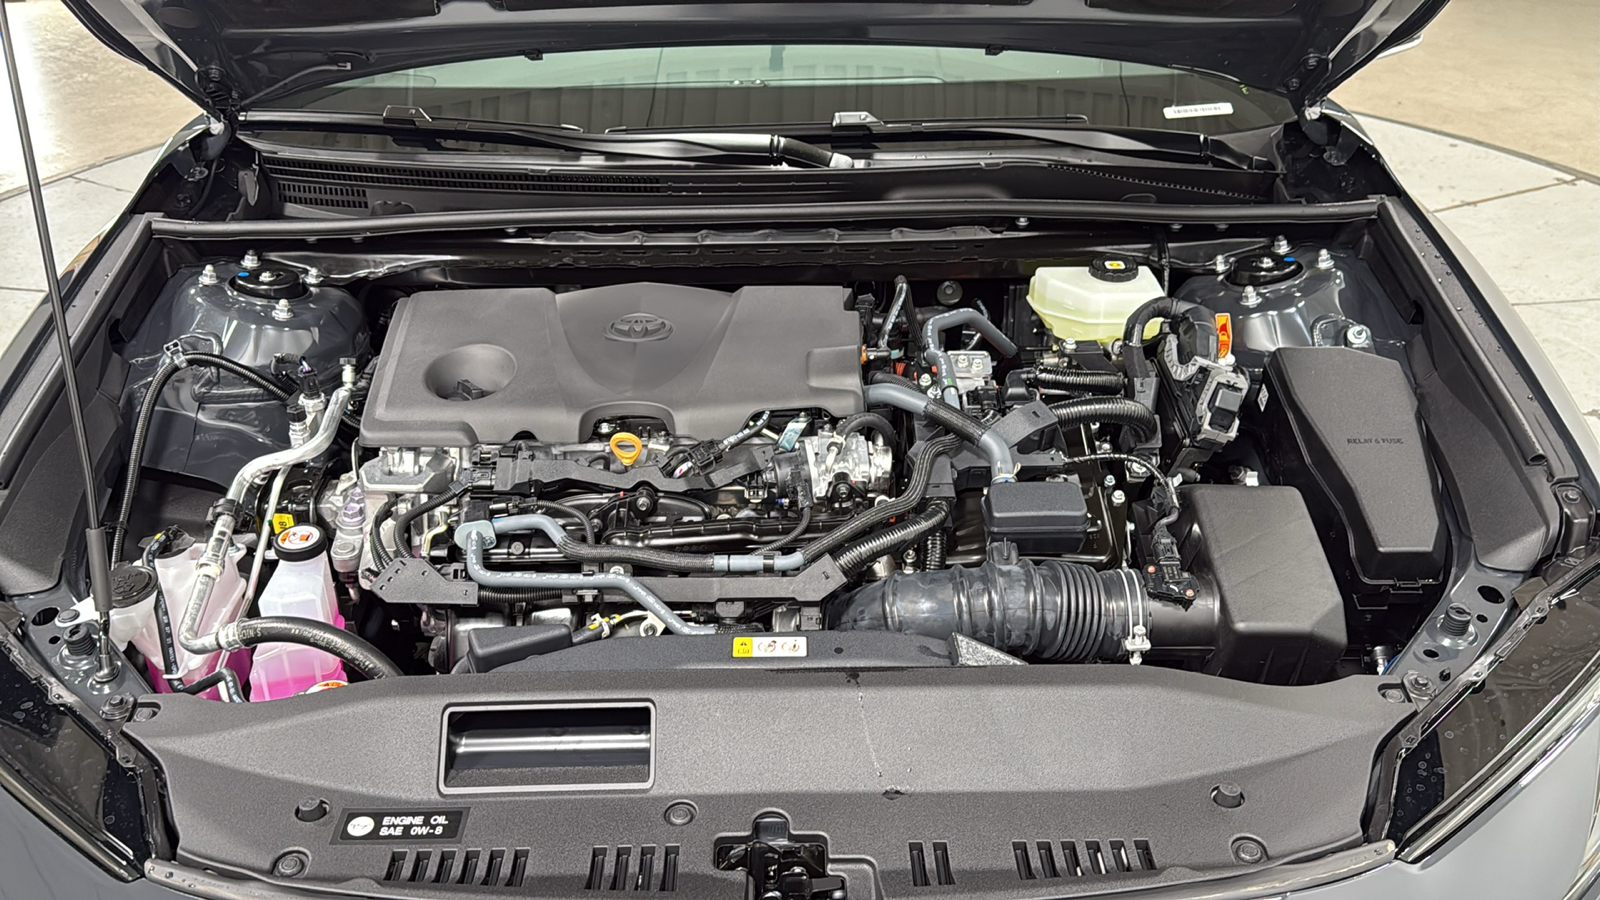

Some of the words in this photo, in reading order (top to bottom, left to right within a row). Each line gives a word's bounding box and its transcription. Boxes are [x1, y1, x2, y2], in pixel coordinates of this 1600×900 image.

[382, 816, 425, 825] ENGINE
[430, 815, 449, 825] OIL
[379, 826, 404, 836] SAE
[410, 826, 443, 836] 0W-8
